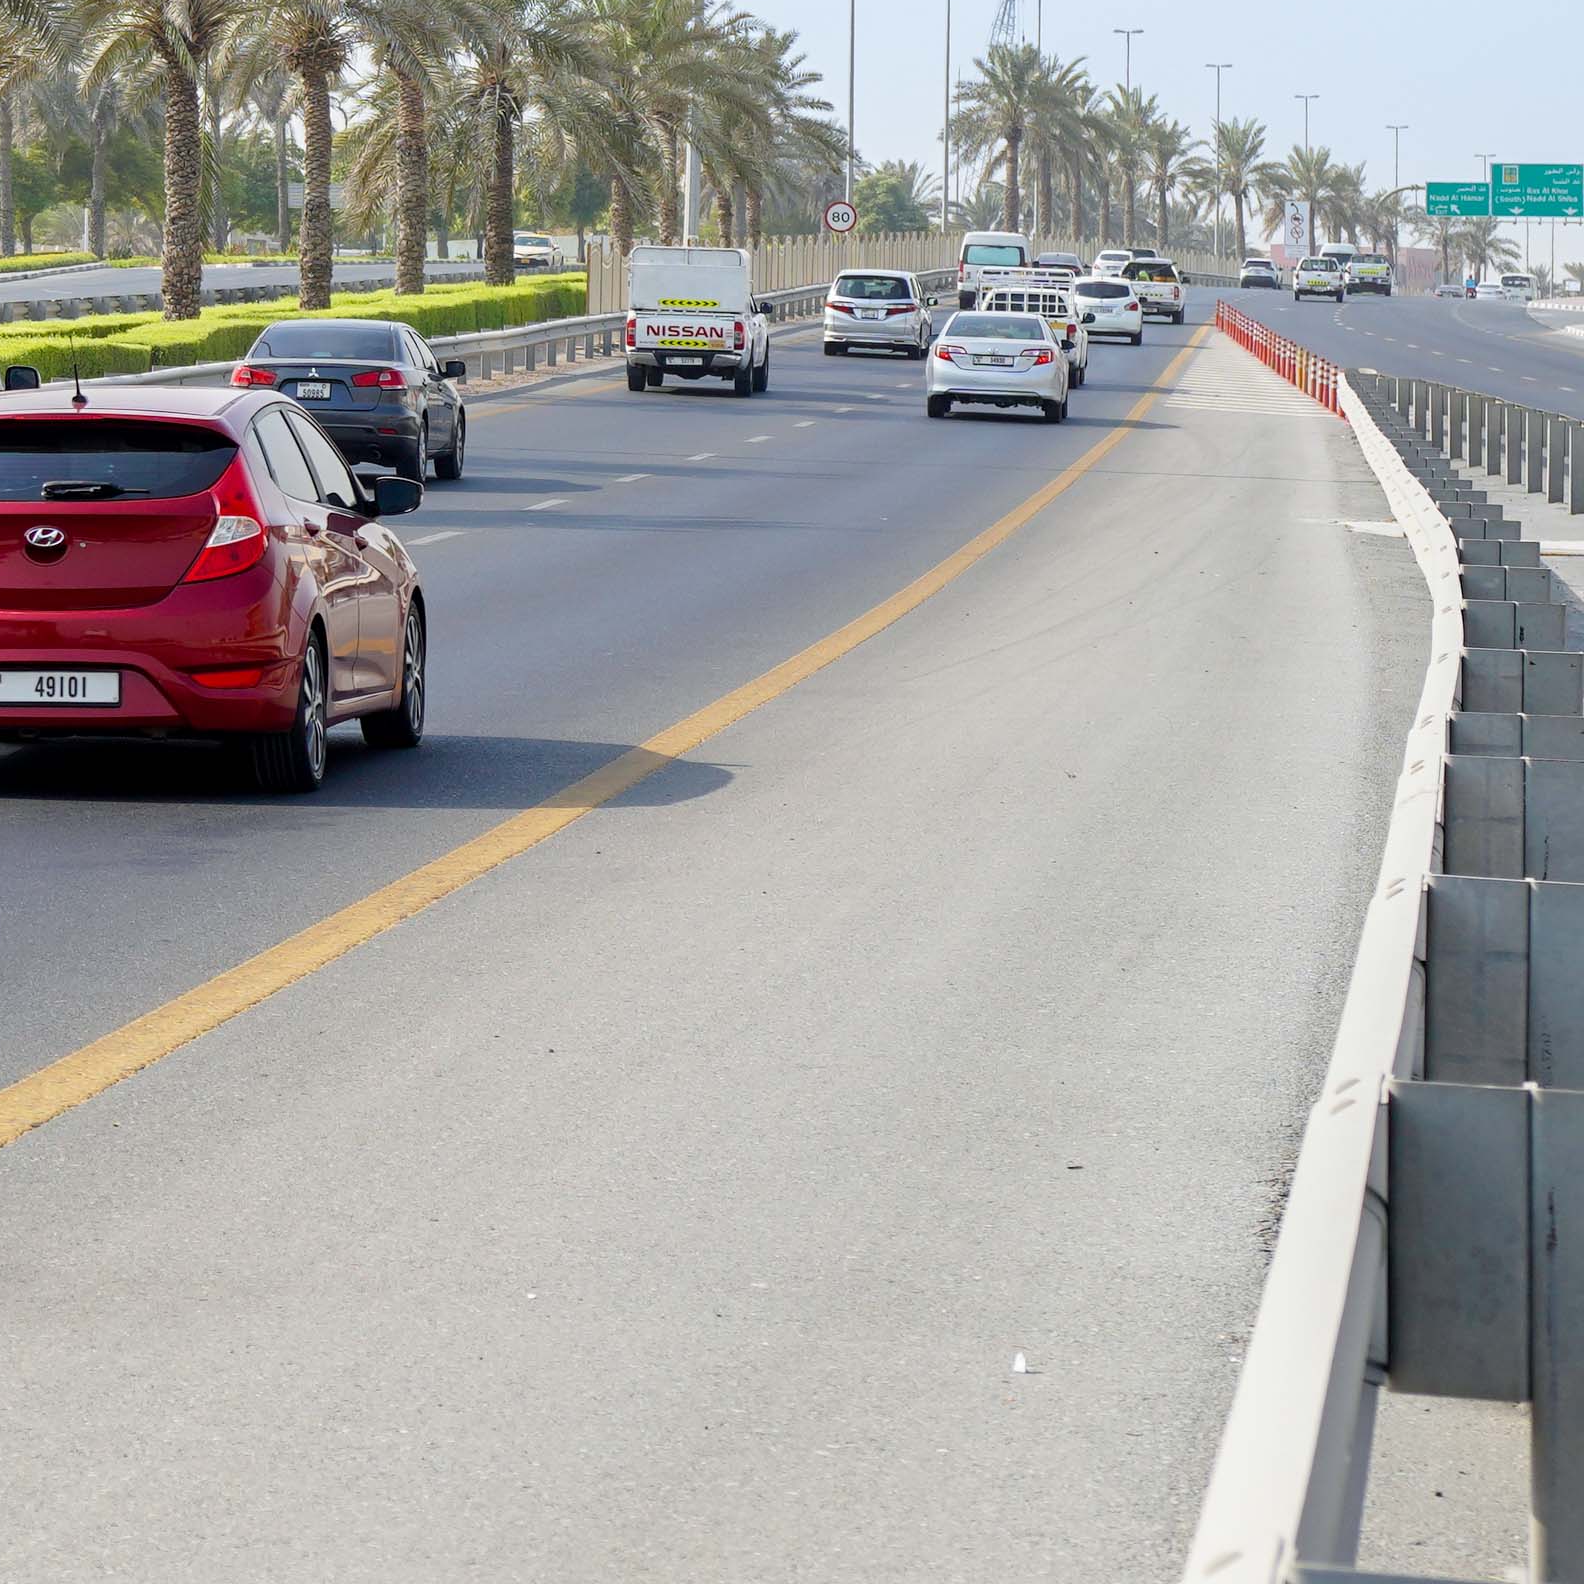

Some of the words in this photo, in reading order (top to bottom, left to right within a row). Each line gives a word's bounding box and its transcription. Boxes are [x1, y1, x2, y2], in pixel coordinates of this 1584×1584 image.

[832, 212, 850, 223] 80
[647, 324, 724, 338] NISSAN
[34, 676, 87, 698] 49101
